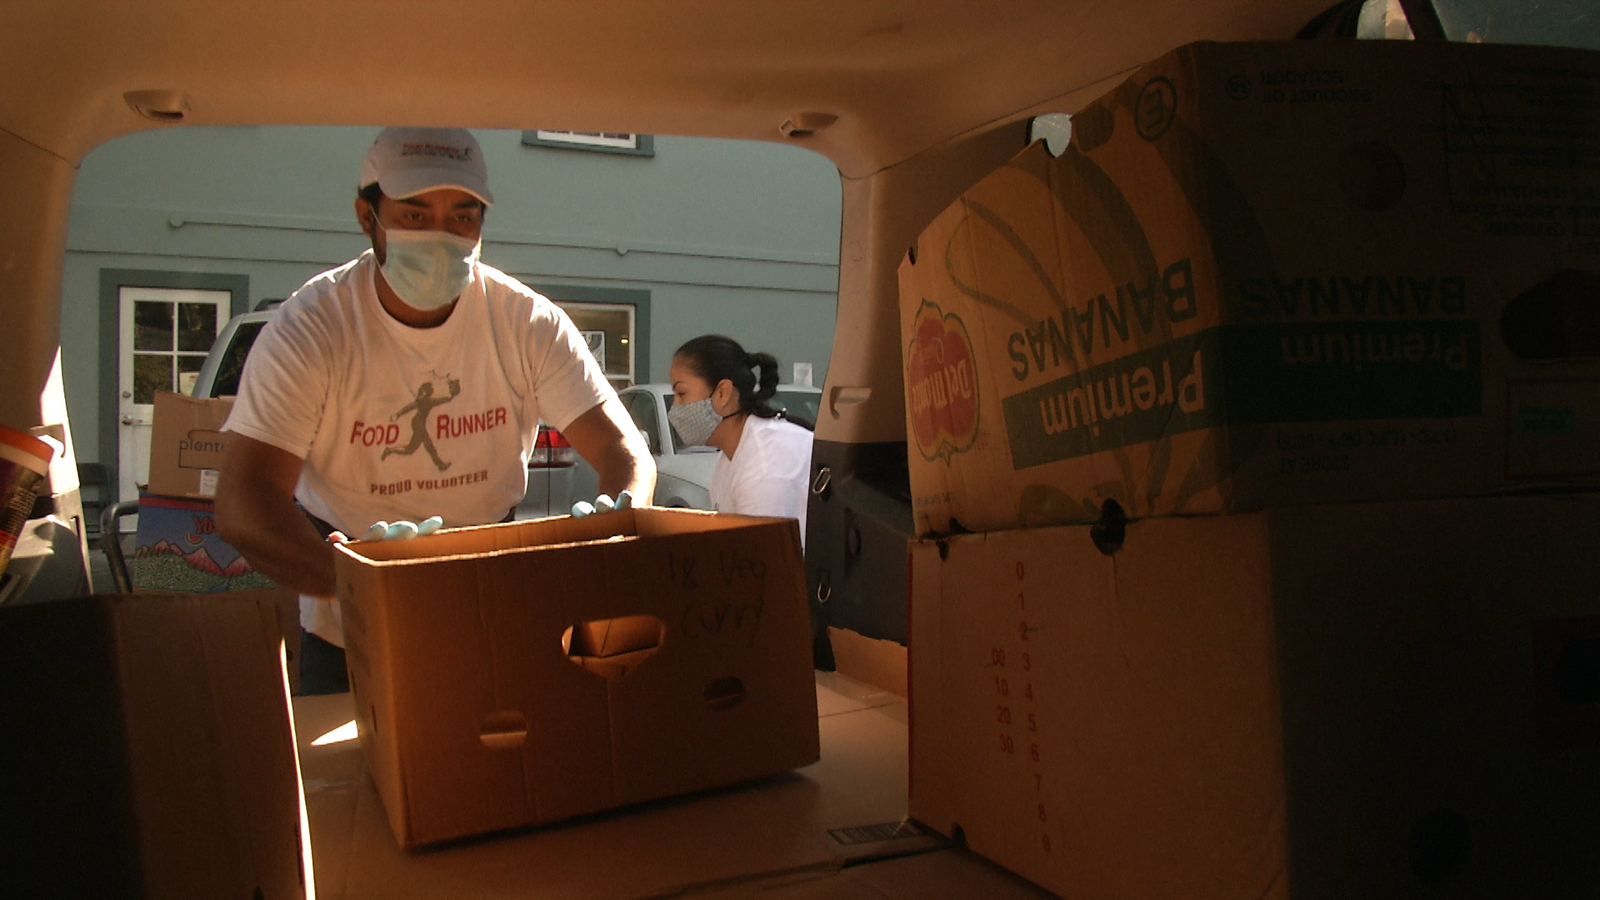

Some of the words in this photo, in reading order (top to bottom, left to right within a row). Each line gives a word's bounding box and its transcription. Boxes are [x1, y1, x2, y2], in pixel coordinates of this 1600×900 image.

[1260, 69, 1344, 86] ECUADOR
[1262, 88, 1286, 105] OF
[1289, 88, 1373, 105] PRODUCT
[1238, 275, 1467, 317] BANANAS
[1007, 257, 1198, 382] BANANAS
[1280, 331, 1469, 373] Premium
[944, 358, 972, 404] Del
[911, 371, 948, 417] Monte
[1039, 349, 1206, 437] Premium
[349, 420, 400, 447] FOOD
[435, 406, 508, 440] RUNNER
[179, 438, 224, 454] plent
[1300, 454, 1352, 474] STORE
[370, 479, 413, 496] PROUD
[417, 469, 489, 491] VOLUNTEER
[1015, 561, 1025, 581] 0
[1016, 592, 1025, 611] 1
[1019, 622, 1029, 641] 2
[991, 646, 1007, 668] 00
[1022, 652, 1032, 672] 3
[995, 676, 1009, 697] 10
[1024, 682, 1034, 702] 4
[996, 705, 1012, 726] 20
[1027, 712, 1037, 733] 5
[999, 734, 1015, 755] 30
[1030, 743, 1040, 763] 6
[1033, 773, 1043, 792] 7
[1038, 803, 1048, 823] 8
